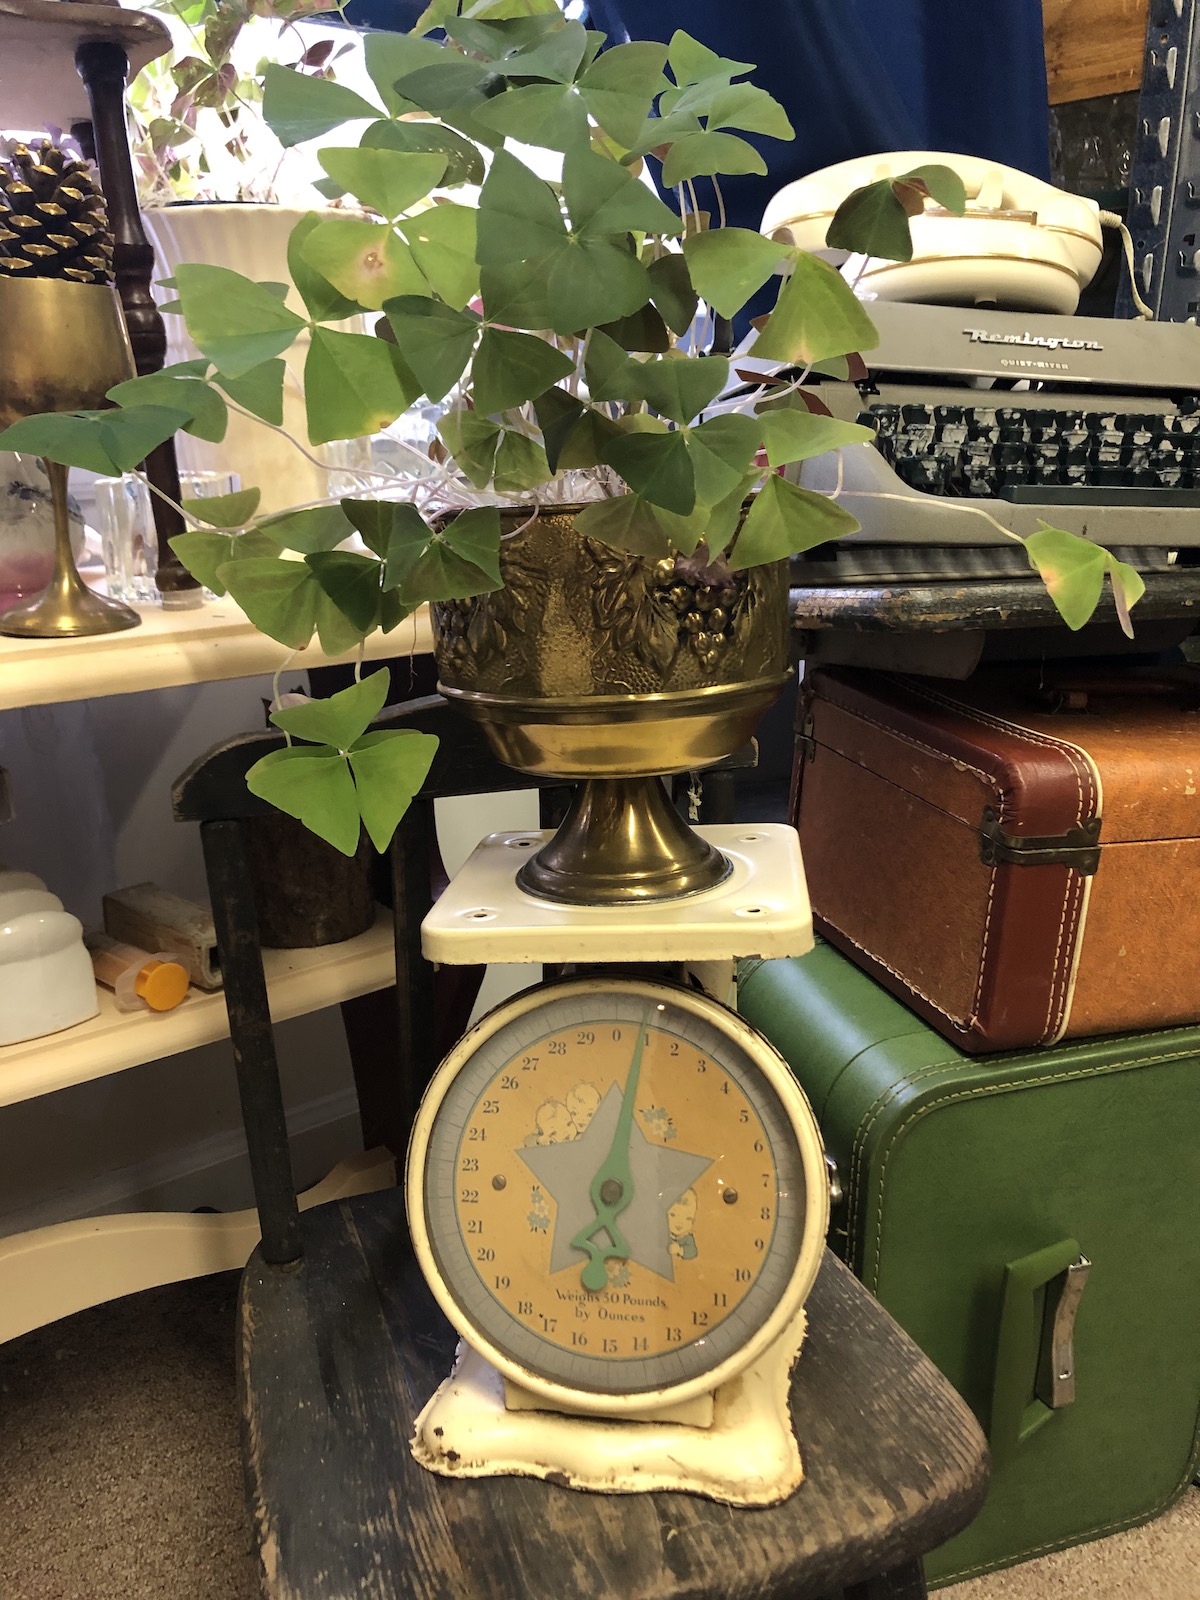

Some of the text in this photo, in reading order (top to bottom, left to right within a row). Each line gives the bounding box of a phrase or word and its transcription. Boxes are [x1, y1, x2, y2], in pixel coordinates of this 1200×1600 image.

[963, 329, 1103, 350] Remington
[577, 1032, 595, 1045] 29
[612, 1028, 621, 1041] 0
[644, 1033, 650, 1046] 1
[548, 1042, 566, 1055] 28
[670, 1042, 679, 1056] 2
[521, 1058, 539, 1071] 27
[697, 1060, 706, 1073] 3
[501, 1076, 518, 1089] 26
[720, 1081, 730, 1095] 4
[483, 1100, 499, 1113] 25
[740, 1110, 748, 1123] 5
[469, 1128, 487, 1141] 24
[754, 1139, 763, 1153] 6
[462, 1159, 479, 1172] 23
[761, 1174, 770, 1187] 7
[461, 1190, 479, 1203] 22
[761, 1207, 770, 1220] 8
[467, 1220, 483, 1233] 21
[755, 1239, 764, 1252] 9
[477, 1248, 495, 1262] 20
[735, 1269, 751, 1282] 10
[495, 1276, 510, 1289] 19
[556, 1289, 600, 1306] Weighs
[623, 1294, 666, 1307] Pounds
[713, 1294, 728, 1307] 11
[518, 1301, 533, 1315] 18
[575, 1306, 645, 1322] by Ounces
[543, 1319, 557, 1332] 17
[692, 1312, 708, 1326] 12
[571, 1332, 587, 1346] 16
[665, 1327, 681, 1341] 13
[602, 1339, 618, 1352] 15
[633, 1337, 649, 1351] 14
